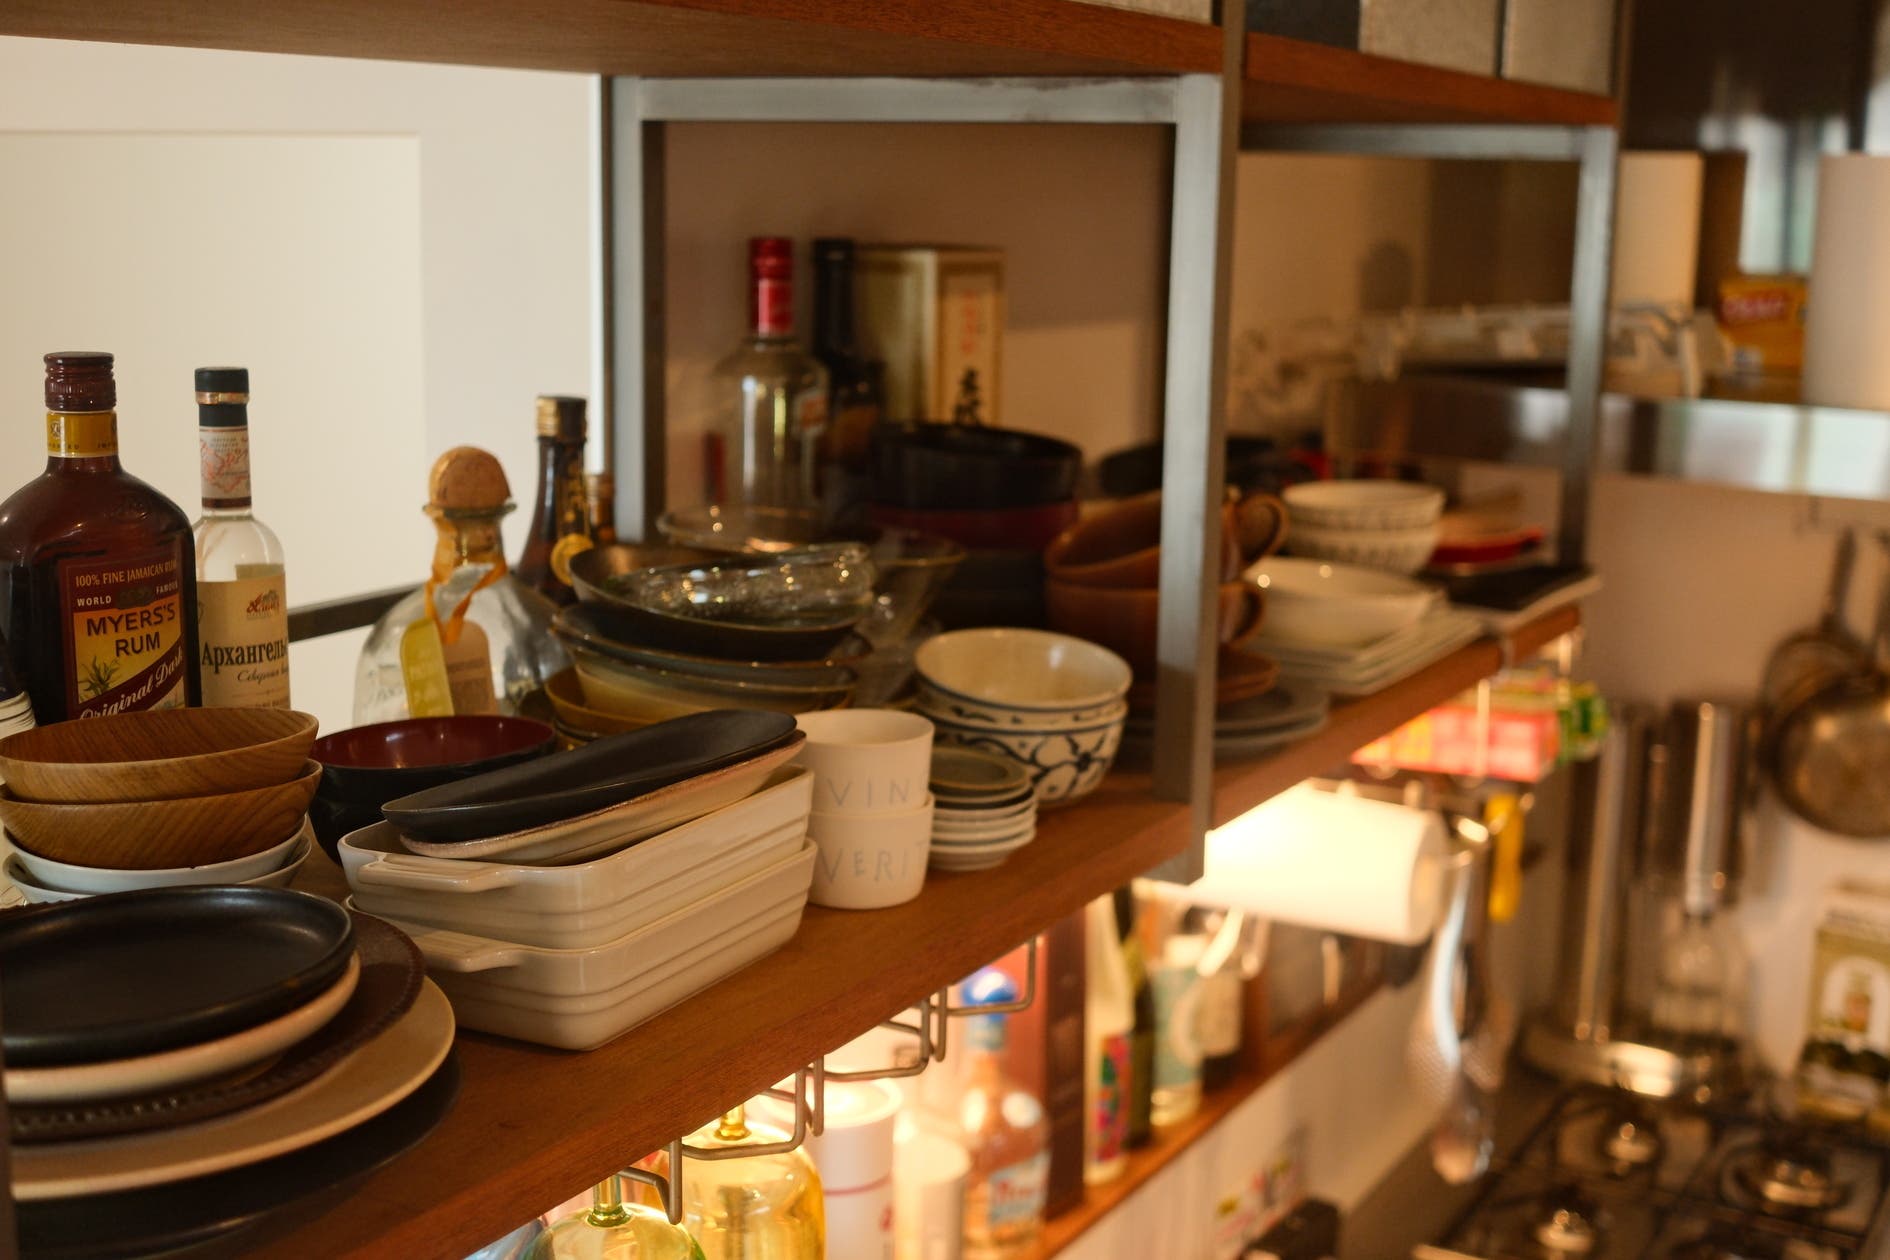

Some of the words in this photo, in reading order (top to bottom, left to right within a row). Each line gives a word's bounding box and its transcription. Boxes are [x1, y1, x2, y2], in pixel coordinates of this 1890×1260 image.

[75, 573, 101, 588] 100%
[103, 570, 126, 585] FINE
[127, 563, 164, 582] JAMAICAN
[77, 595, 112, 607] WORLD
[86, 603, 176, 636] MYERS'S
[115, 632, 160, 657] RUM
[80, 673, 154, 720] Original
